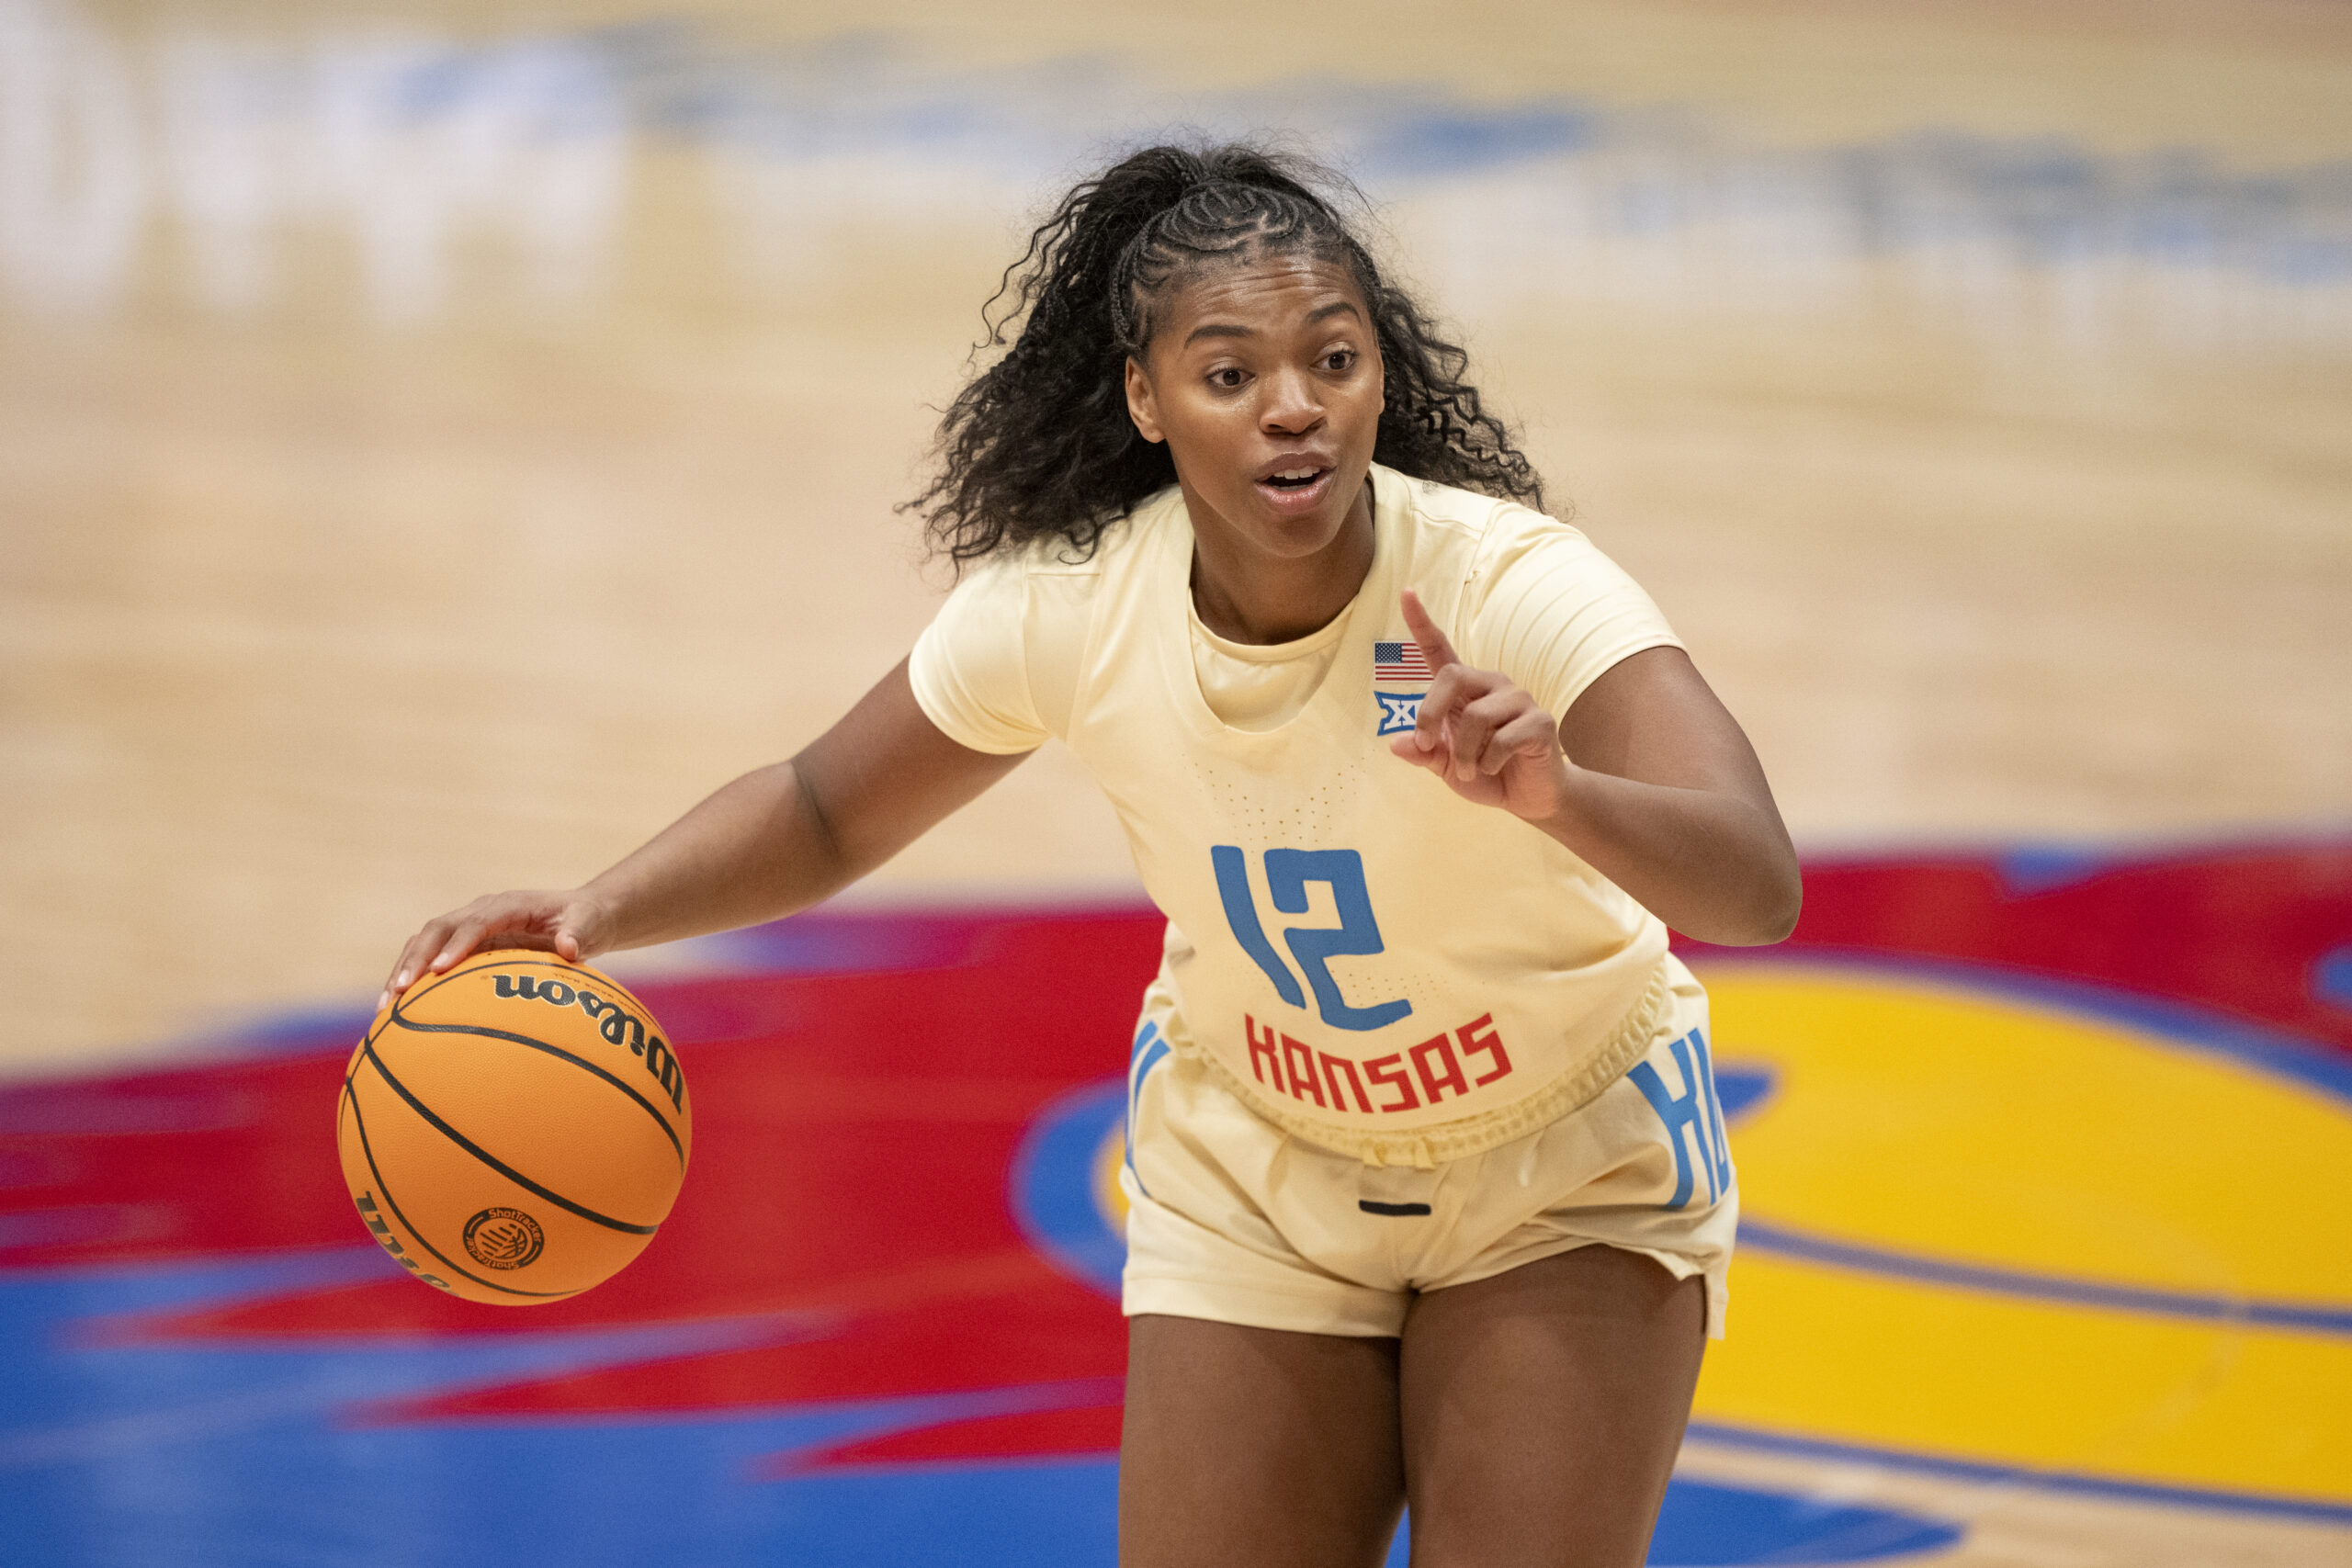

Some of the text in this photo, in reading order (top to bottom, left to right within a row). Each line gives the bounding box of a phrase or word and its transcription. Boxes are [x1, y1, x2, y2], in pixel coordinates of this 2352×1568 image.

[1210, 844, 1413, 1032] 12
[492, 974, 683, 1115] Wilson
[1244, 1012, 1513, 1114] KANSAS
[487, 1208, 542, 1244] ShotTracker
